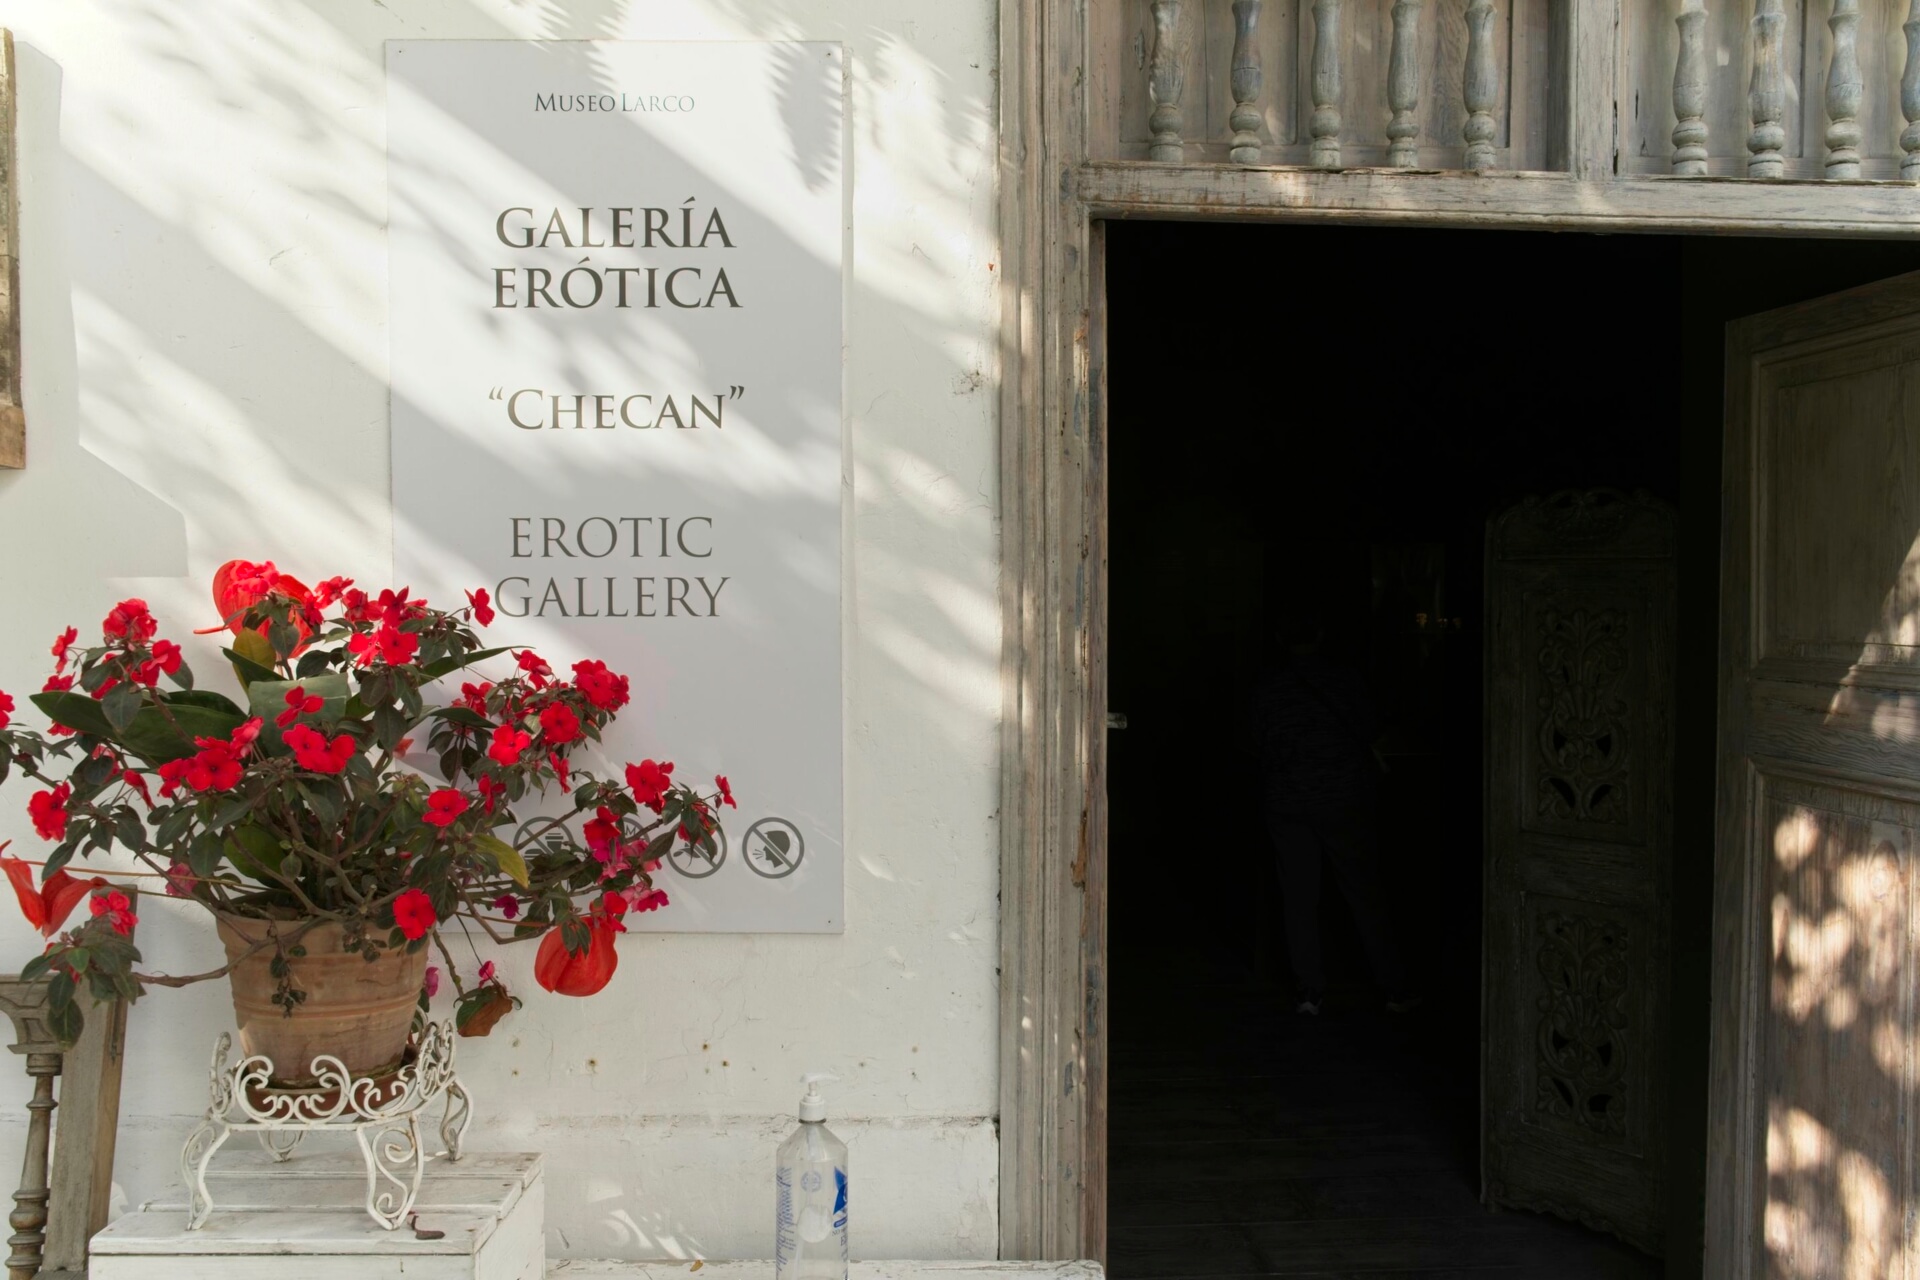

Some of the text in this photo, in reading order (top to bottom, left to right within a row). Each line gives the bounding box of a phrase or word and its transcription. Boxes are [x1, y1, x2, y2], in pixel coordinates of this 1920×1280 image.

[535, 93, 695, 113] MUSEO LARCO
[496, 196, 737, 249] GALERÍA
[491, 256, 744, 309] ERÓTICA
[509, 516, 713, 558] EROTIC
[495, 576, 731, 618] GALLERY
